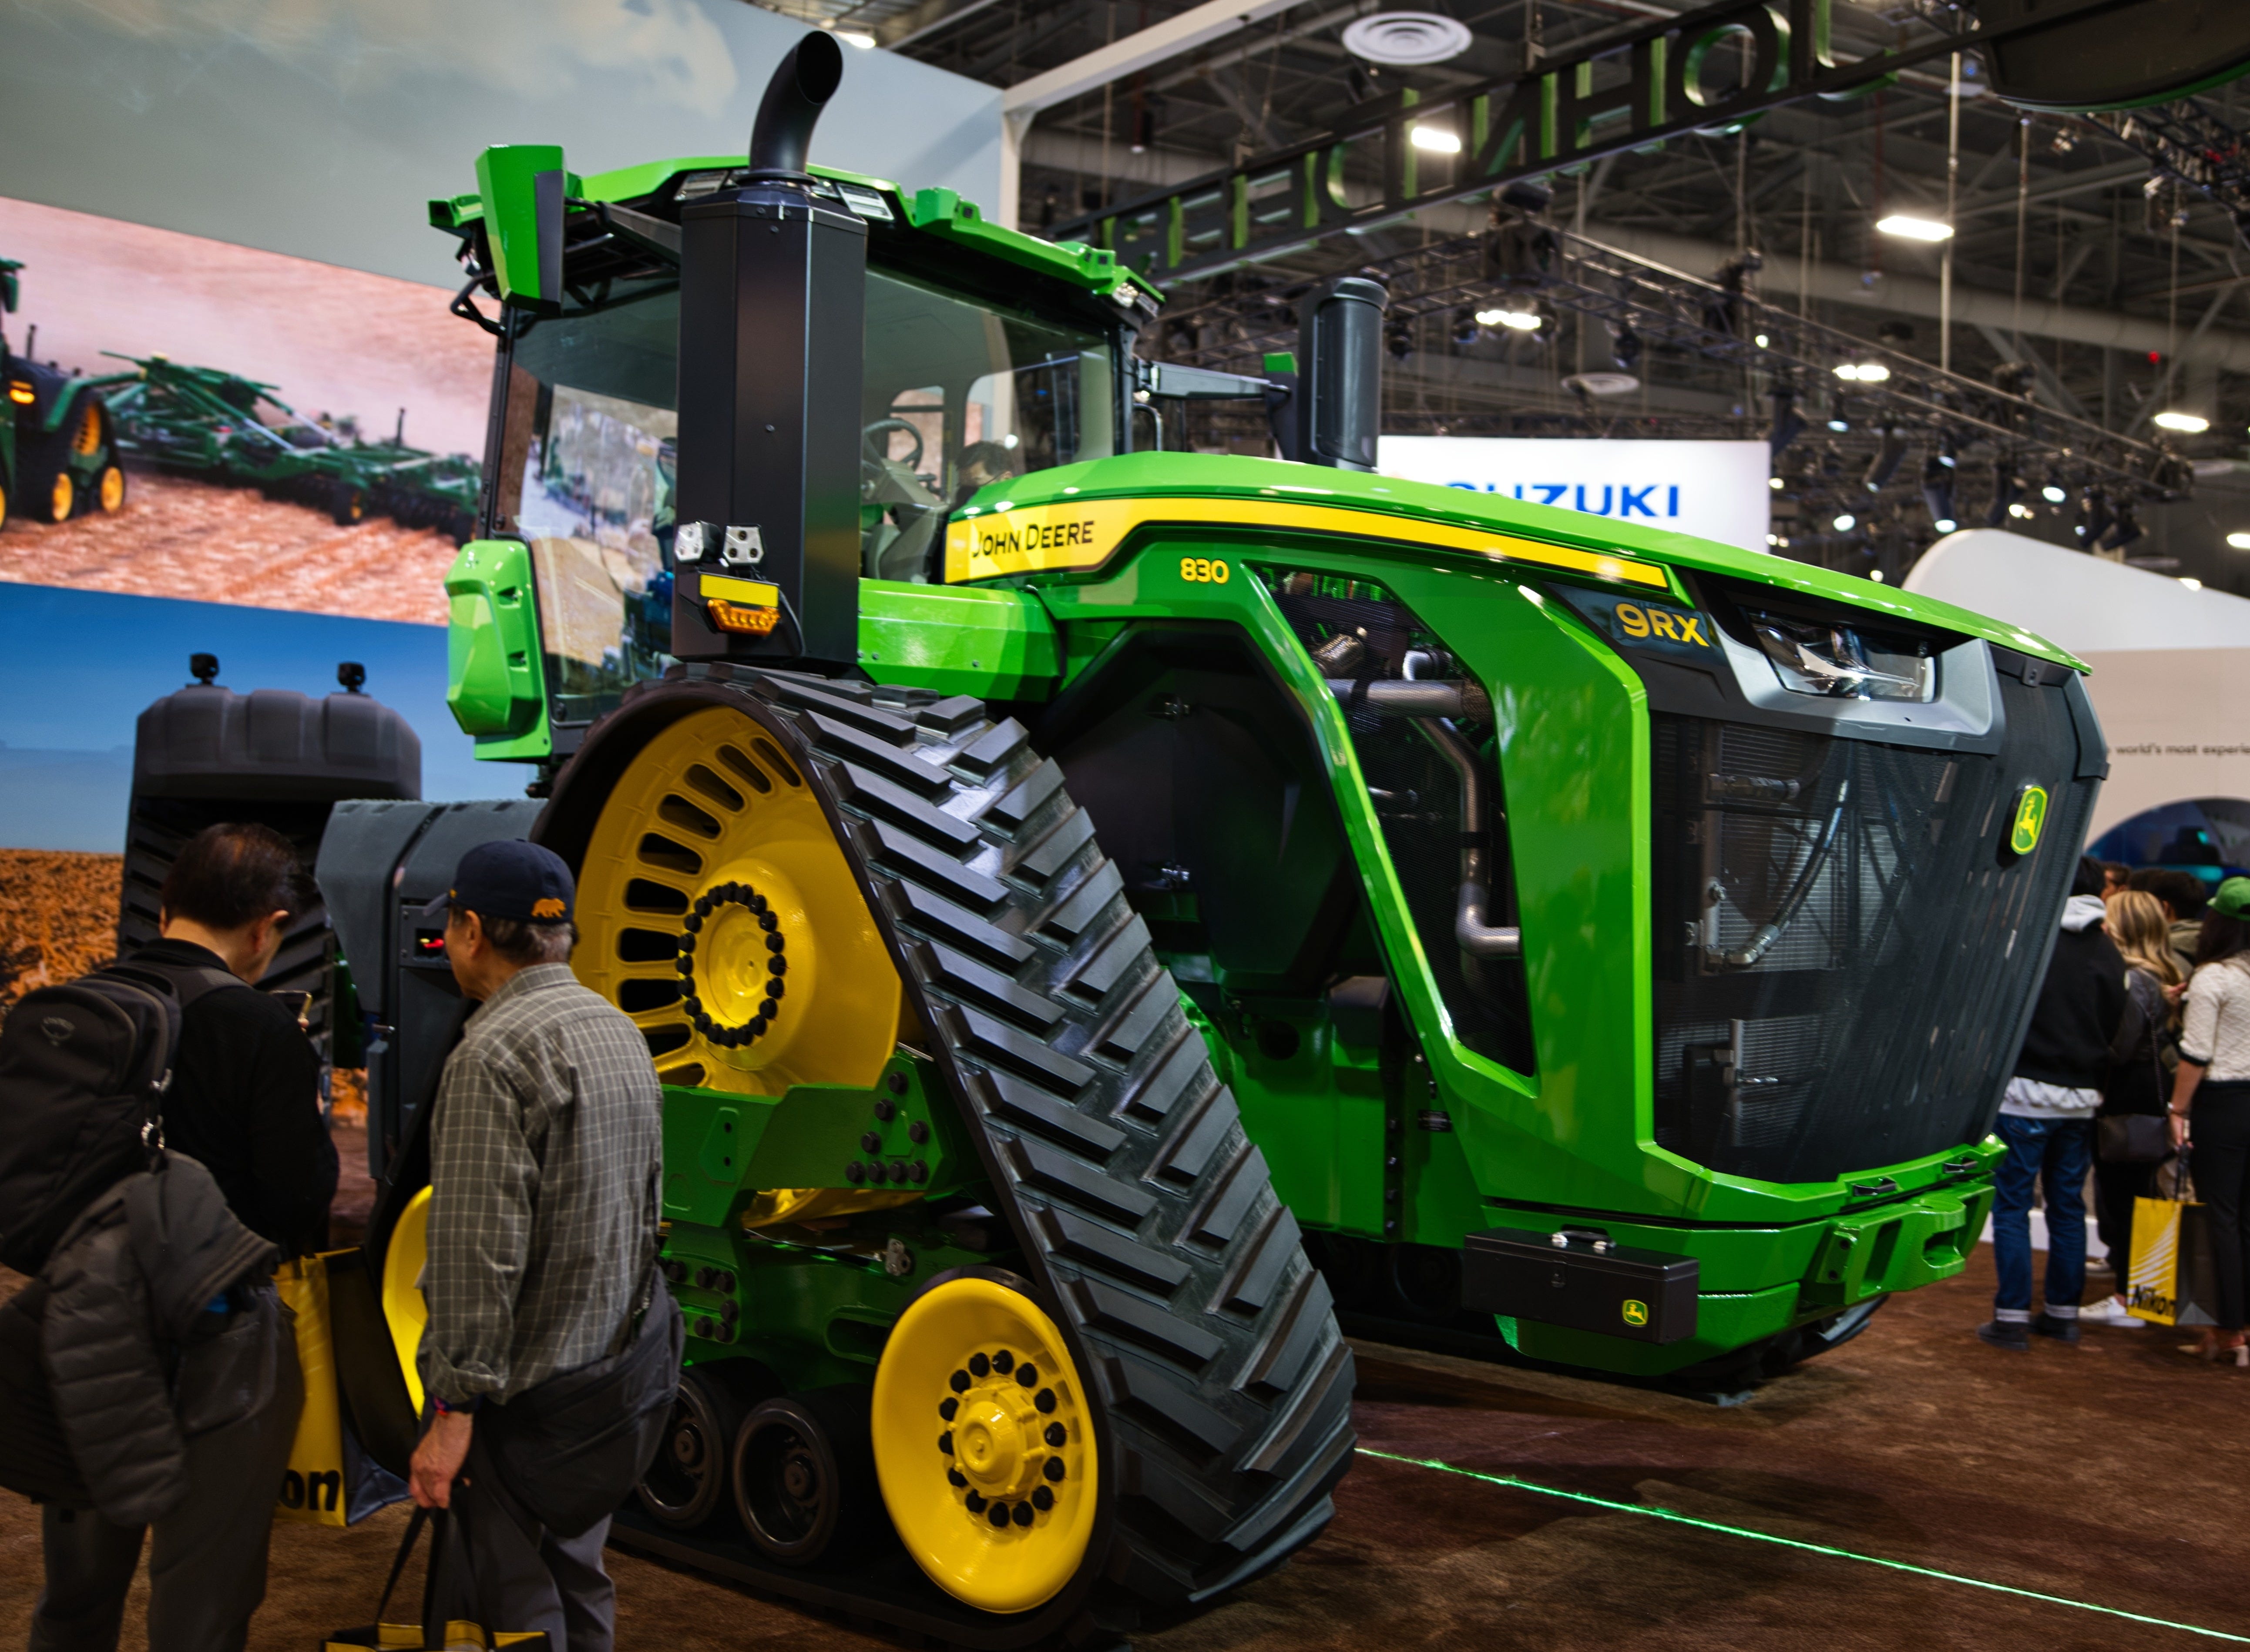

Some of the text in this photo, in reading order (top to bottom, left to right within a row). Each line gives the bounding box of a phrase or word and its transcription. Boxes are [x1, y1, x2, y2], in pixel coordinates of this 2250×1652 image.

[1444, 481, 1679, 517] ZUKI
[971, 520, 1095, 557] JOHN DEERE
[1180, 556, 1230, 585] 830
[1615, 603, 1710, 647] 9RX
[2116, 742, 2162, 754] world's
[2165, 744, 2197, 754] most
[277, 1469, 341, 1512] on
